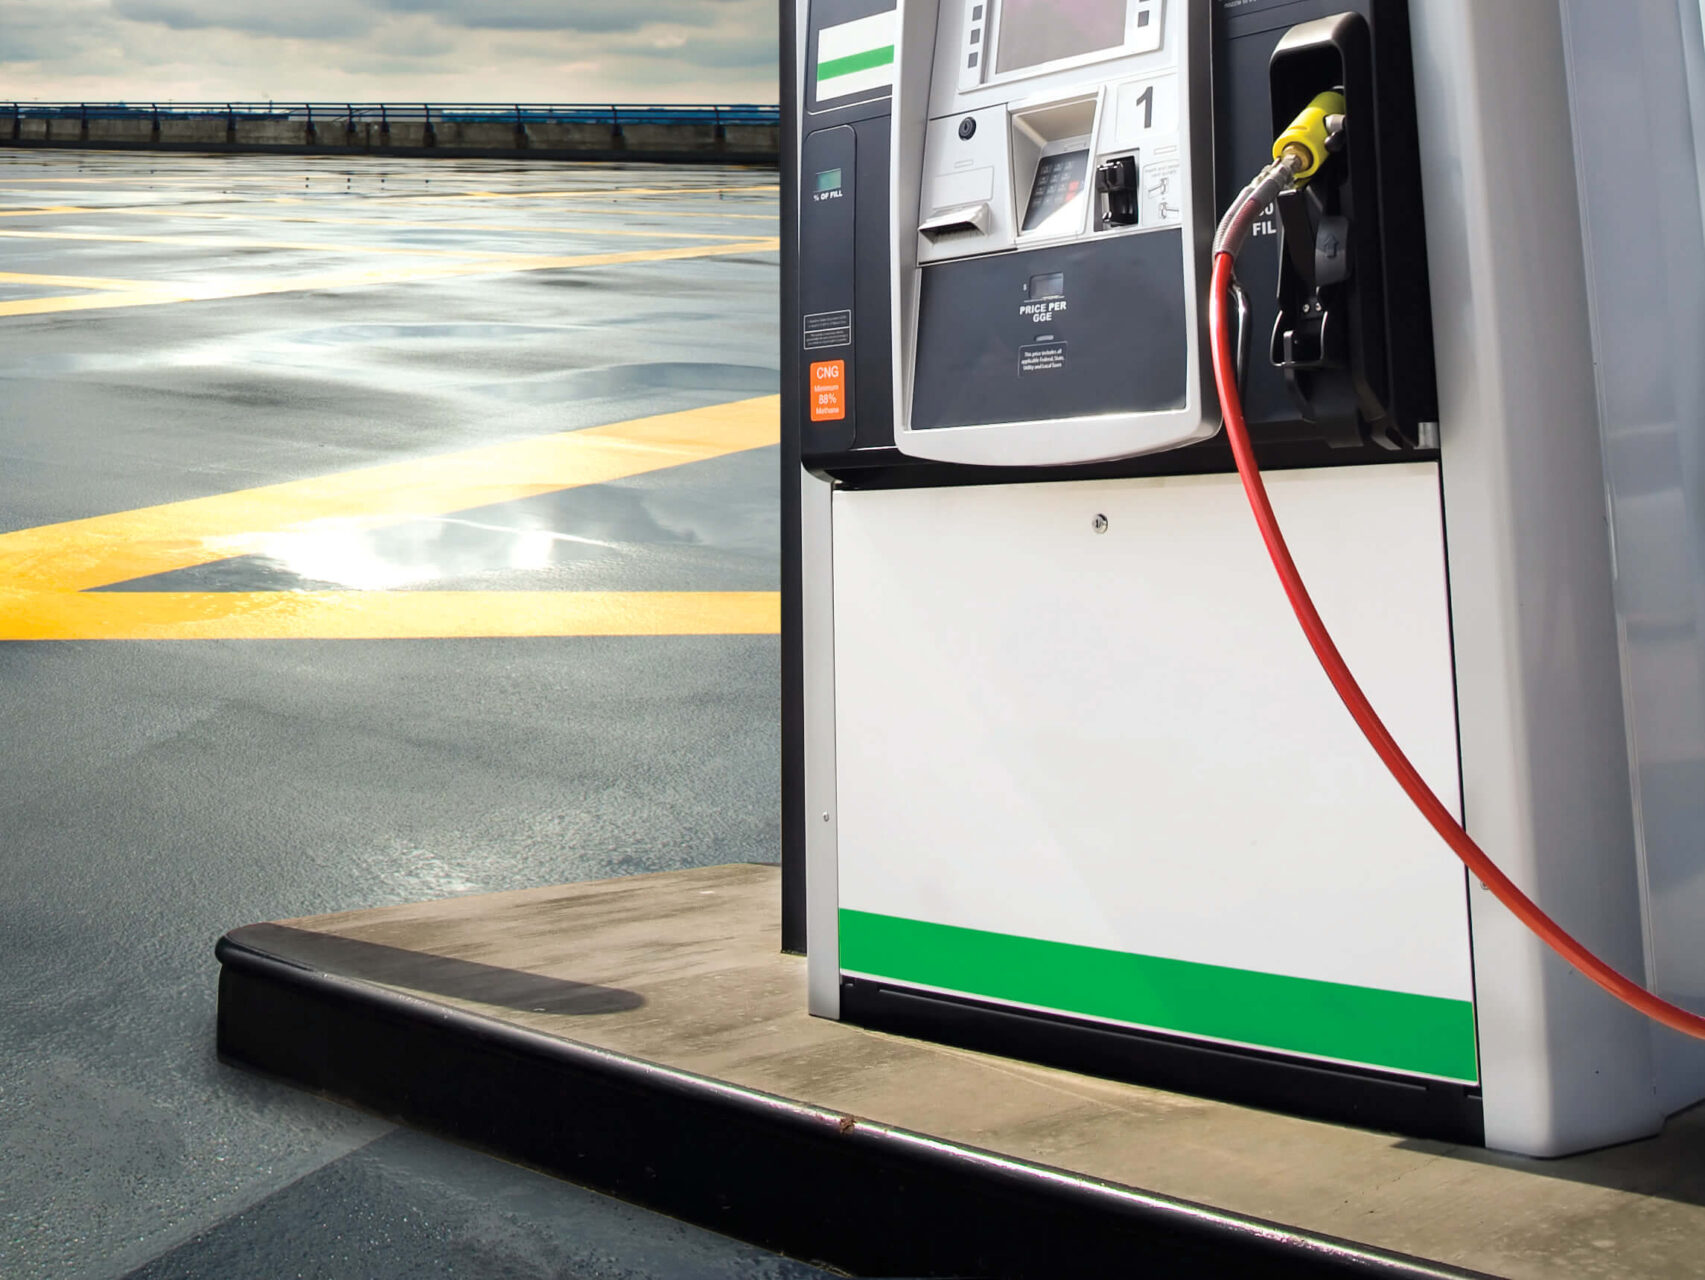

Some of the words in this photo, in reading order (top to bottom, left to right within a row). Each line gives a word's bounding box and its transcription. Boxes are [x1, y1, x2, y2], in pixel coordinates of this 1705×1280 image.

[1136, 86, 1153, 129] 1
[821, 192, 829, 200] OF
[830, 190, 842, 198] FILL
[1019, 303, 1046, 315] PRICE
[1049, 301, 1067, 311] PER
[1033, 312, 1052, 322] GGE
[817, 365, 839, 379] CNG
[819, 393, 836, 404] 88%
